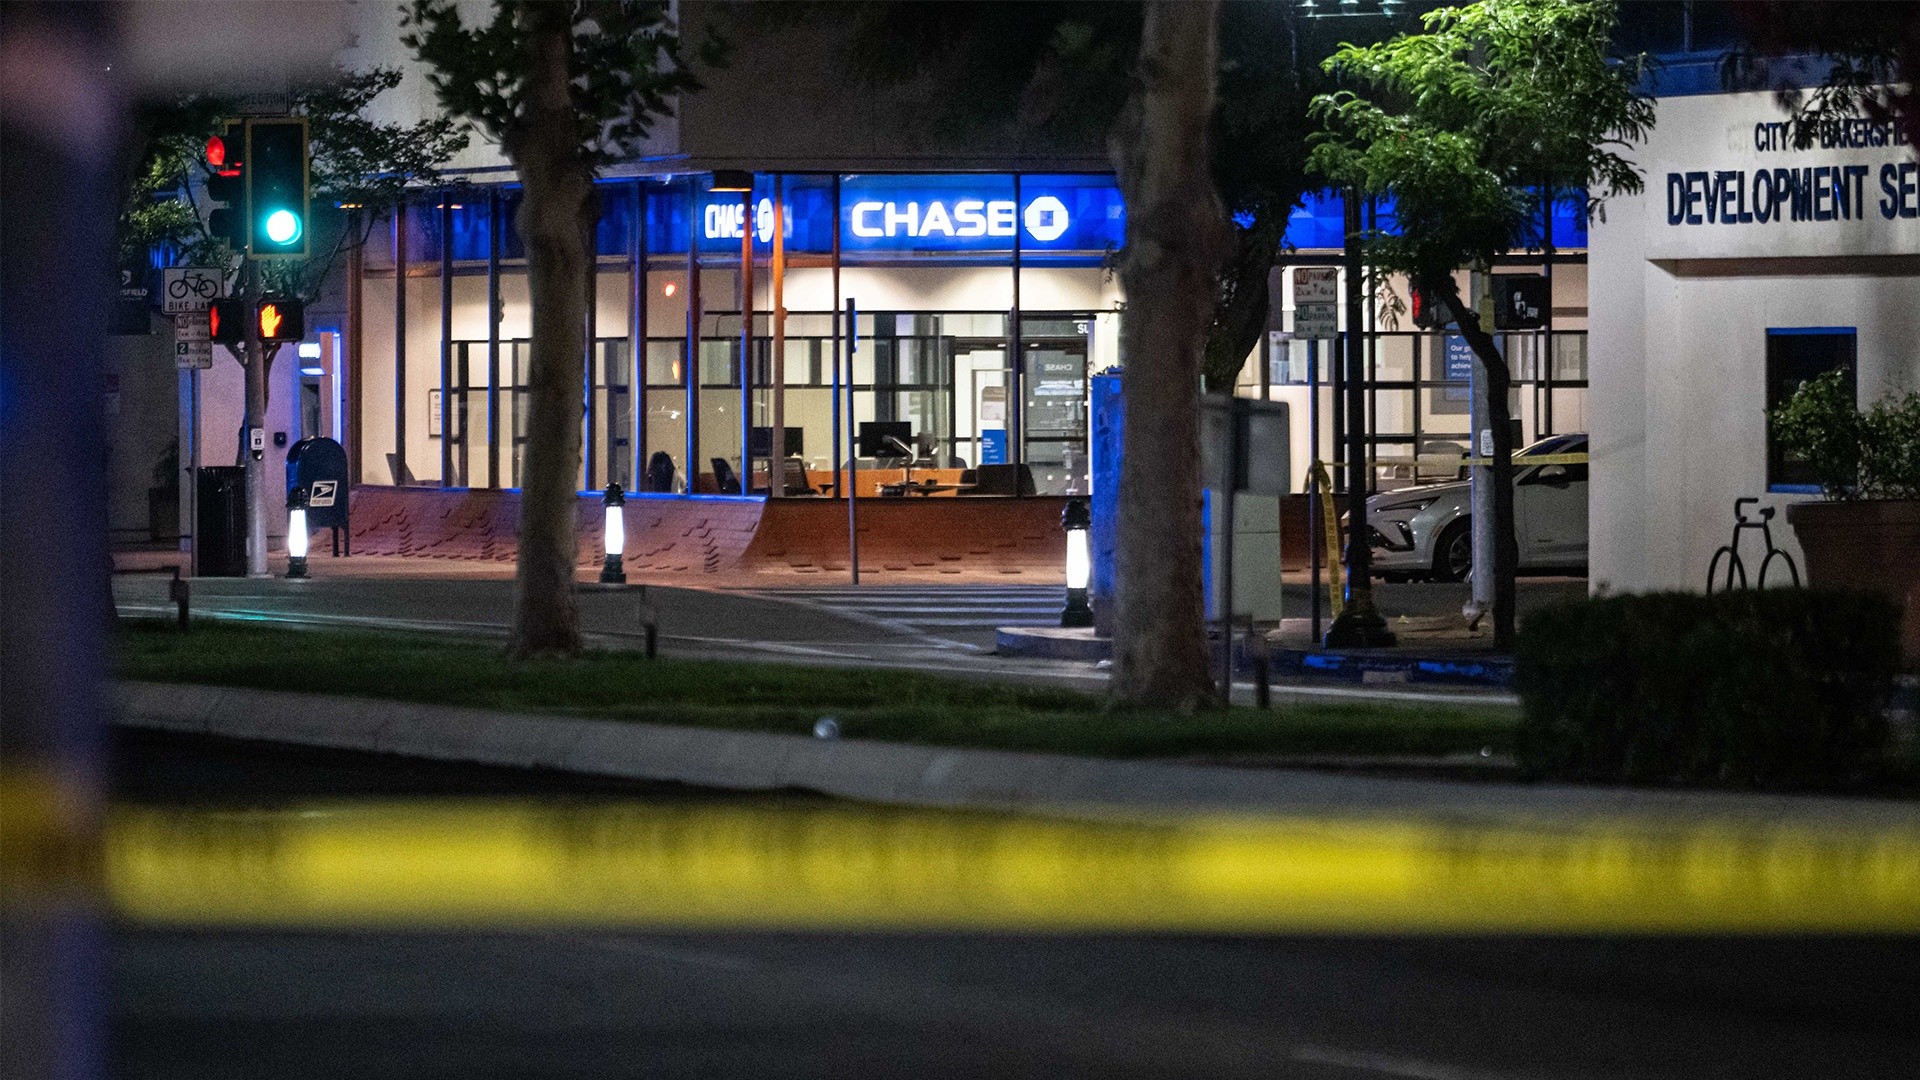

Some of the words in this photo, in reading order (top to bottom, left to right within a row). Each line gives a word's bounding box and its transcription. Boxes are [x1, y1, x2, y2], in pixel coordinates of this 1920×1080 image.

[1754, 121, 1792, 152] CITY
[1820, 118, 1909, 150] BAKERSFIE
[1667, 164, 1869, 226] DEVELOPMENT
[1879, 162, 1920, 220] SE
[851, 201, 1017, 238] CHASE
[169, 301, 189, 311] BIKE
[195, 301, 210, 311] LA
[180, 344, 187, 354] 2
